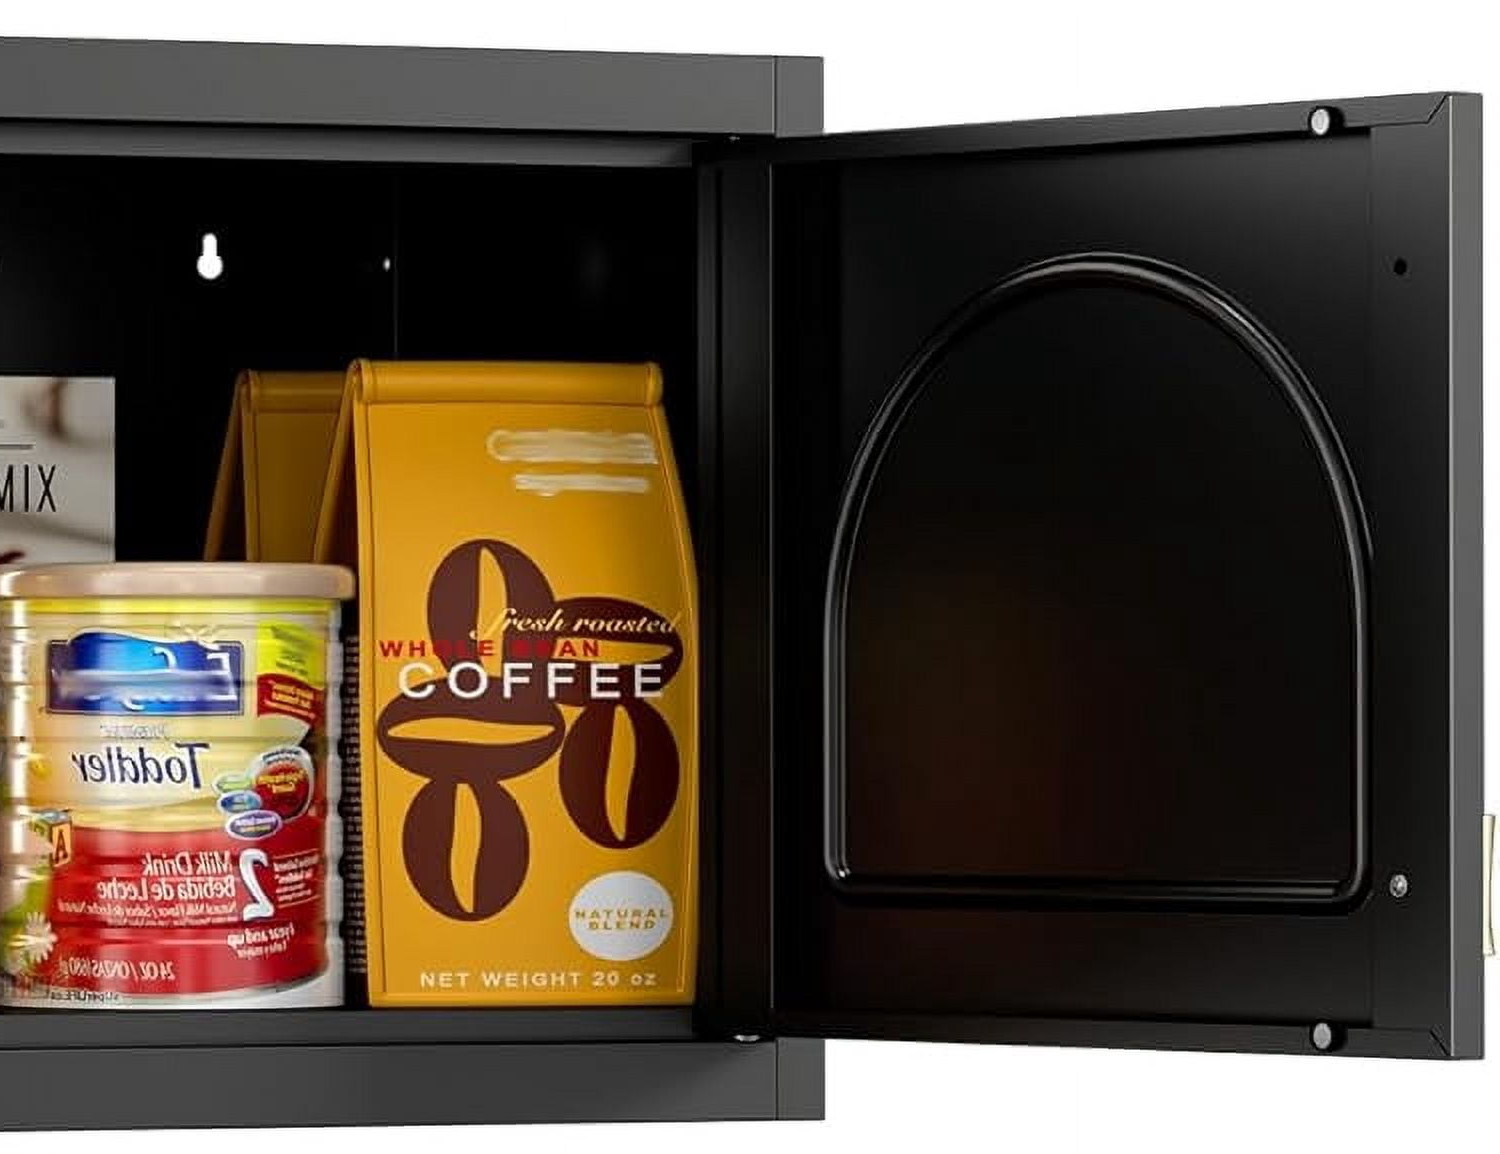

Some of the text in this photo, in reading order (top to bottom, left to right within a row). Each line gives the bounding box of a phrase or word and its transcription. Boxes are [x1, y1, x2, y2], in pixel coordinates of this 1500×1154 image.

[469, 607, 680, 640] fresh roasted
[509, 639, 600, 657] AN
[399, 661, 664, 699] COFFEE
[575, 907, 668, 919] NATURAL
[588, 920, 656, 931] BLEND
[420, 972, 657, 988] NET WEIGHT 20 oz
